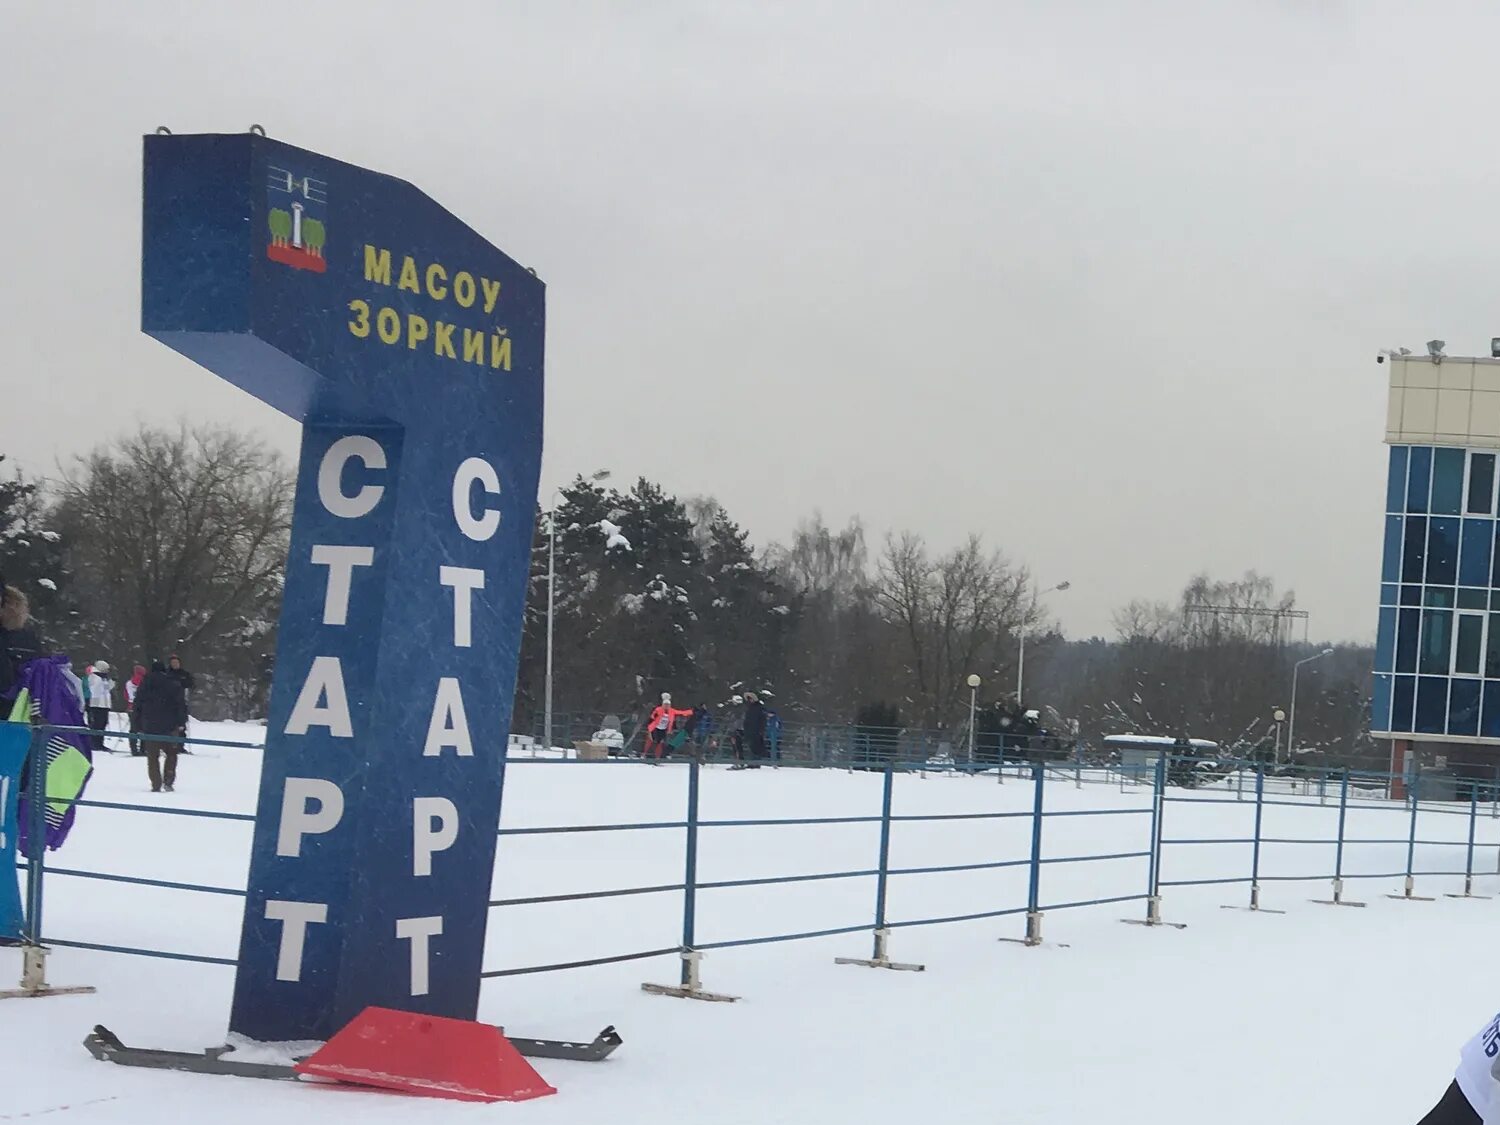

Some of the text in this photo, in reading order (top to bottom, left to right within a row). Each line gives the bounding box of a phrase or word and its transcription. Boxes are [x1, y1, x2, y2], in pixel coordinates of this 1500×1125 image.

[348, 299, 512, 371] ЗОРКИЙ
[364, 244, 501, 314] МАСОУ
[264, 435, 388, 982] СТАРТ
[396, 456, 501, 996] СТАРТ
